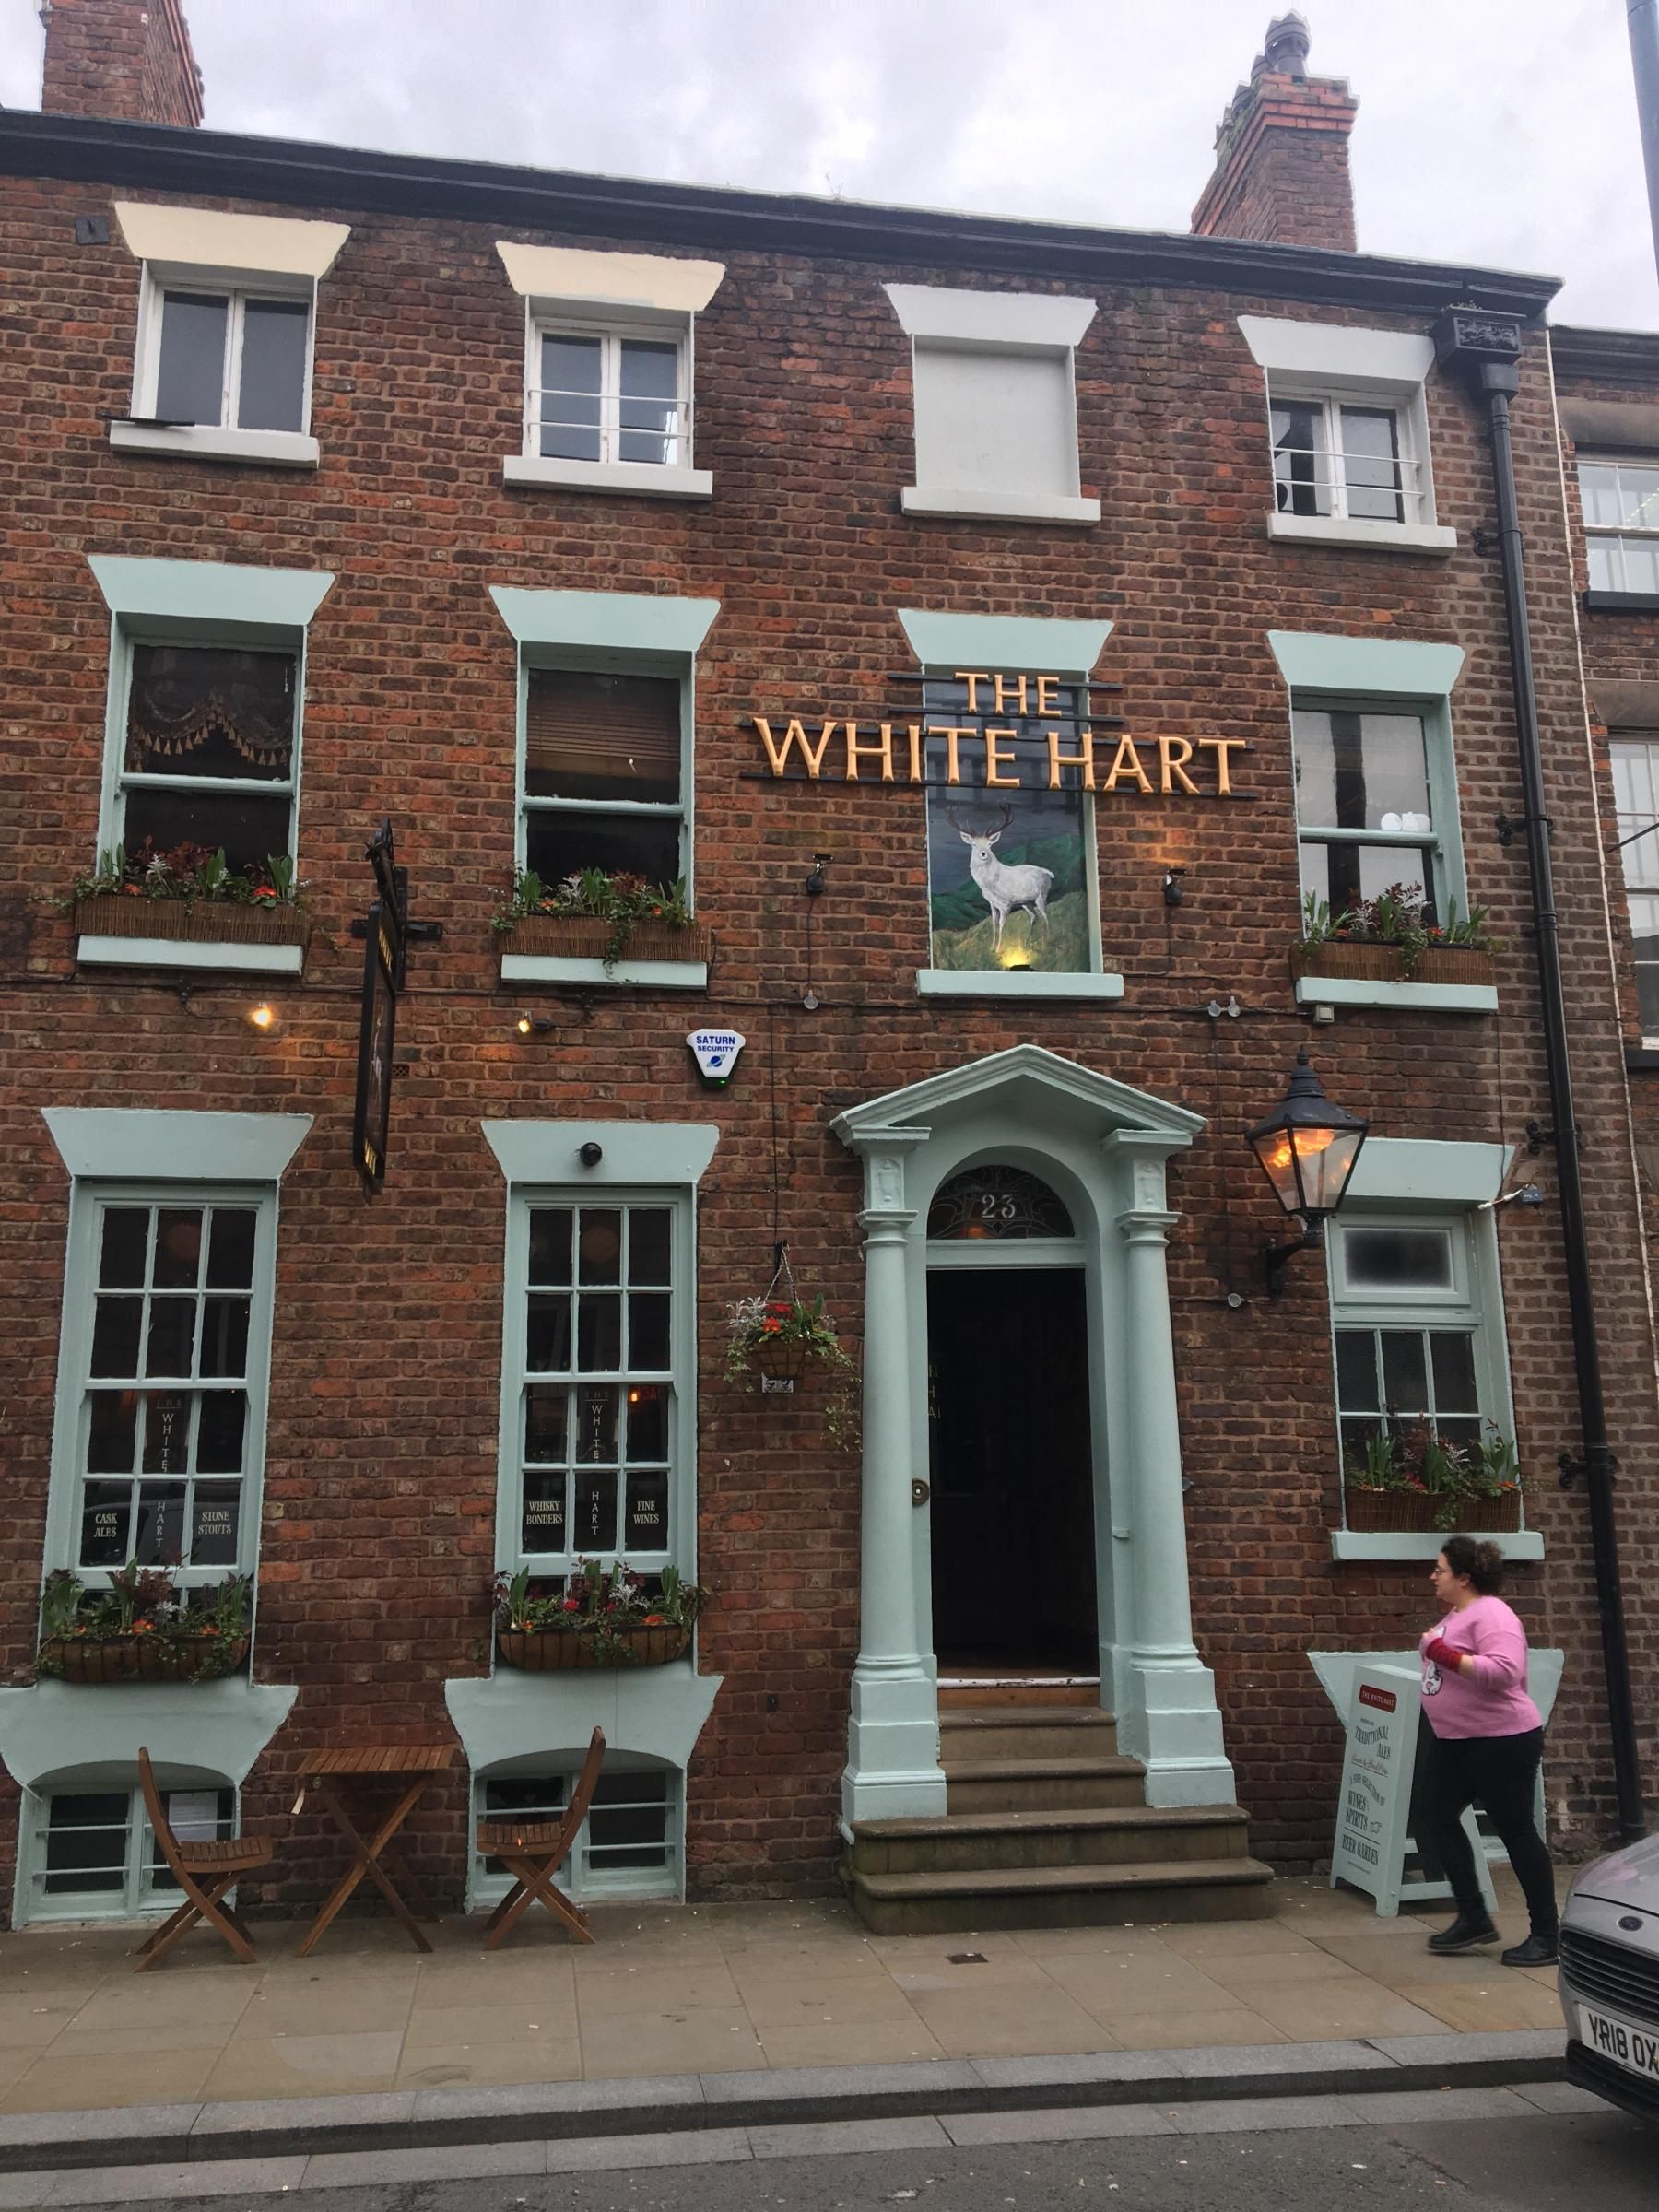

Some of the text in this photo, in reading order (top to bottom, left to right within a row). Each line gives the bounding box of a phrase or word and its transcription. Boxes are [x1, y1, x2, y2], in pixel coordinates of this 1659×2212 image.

[953, 671, 1063, 717] THE
[752, 717, 1247, 796] WHITE HART
[696, 1035, 735, 1045] SATURN
[981, 1194, 1016, 1218] 23
[161, 1413, 175, 1472] WHITE
[591, 1405, 604, 1460] WHITE
[202, 1511, 229, 1522] STONE
[529, 1500, 561, 1512] WHISKY
[591, 1490, 599, 1536] HART
[637, 1500, 655, 1512] FINE
[95, 1513, 118, 1524] CASK
[155, 1501, 166, 1548] HART
[525, 1513, 563, 1525] BONDERS
[633, 1513, 660, 1524] WINES
[93, 1526, 117, 1538] ALES
[198, 1524, 231, 1535] STOUTS
[1355, 1725, 1389, 1746] TRADITIONAL
[1376, 1742, 1391, 1760] ALES
[1348, 1790, 1366, 1812] WINES
[1345, 1806, 1368, 1831] SPIRITS
[1342, 1833, 1379, 1866] BEER GARDEN
[1588, 2013, 1659, 2075] YR18 OX
